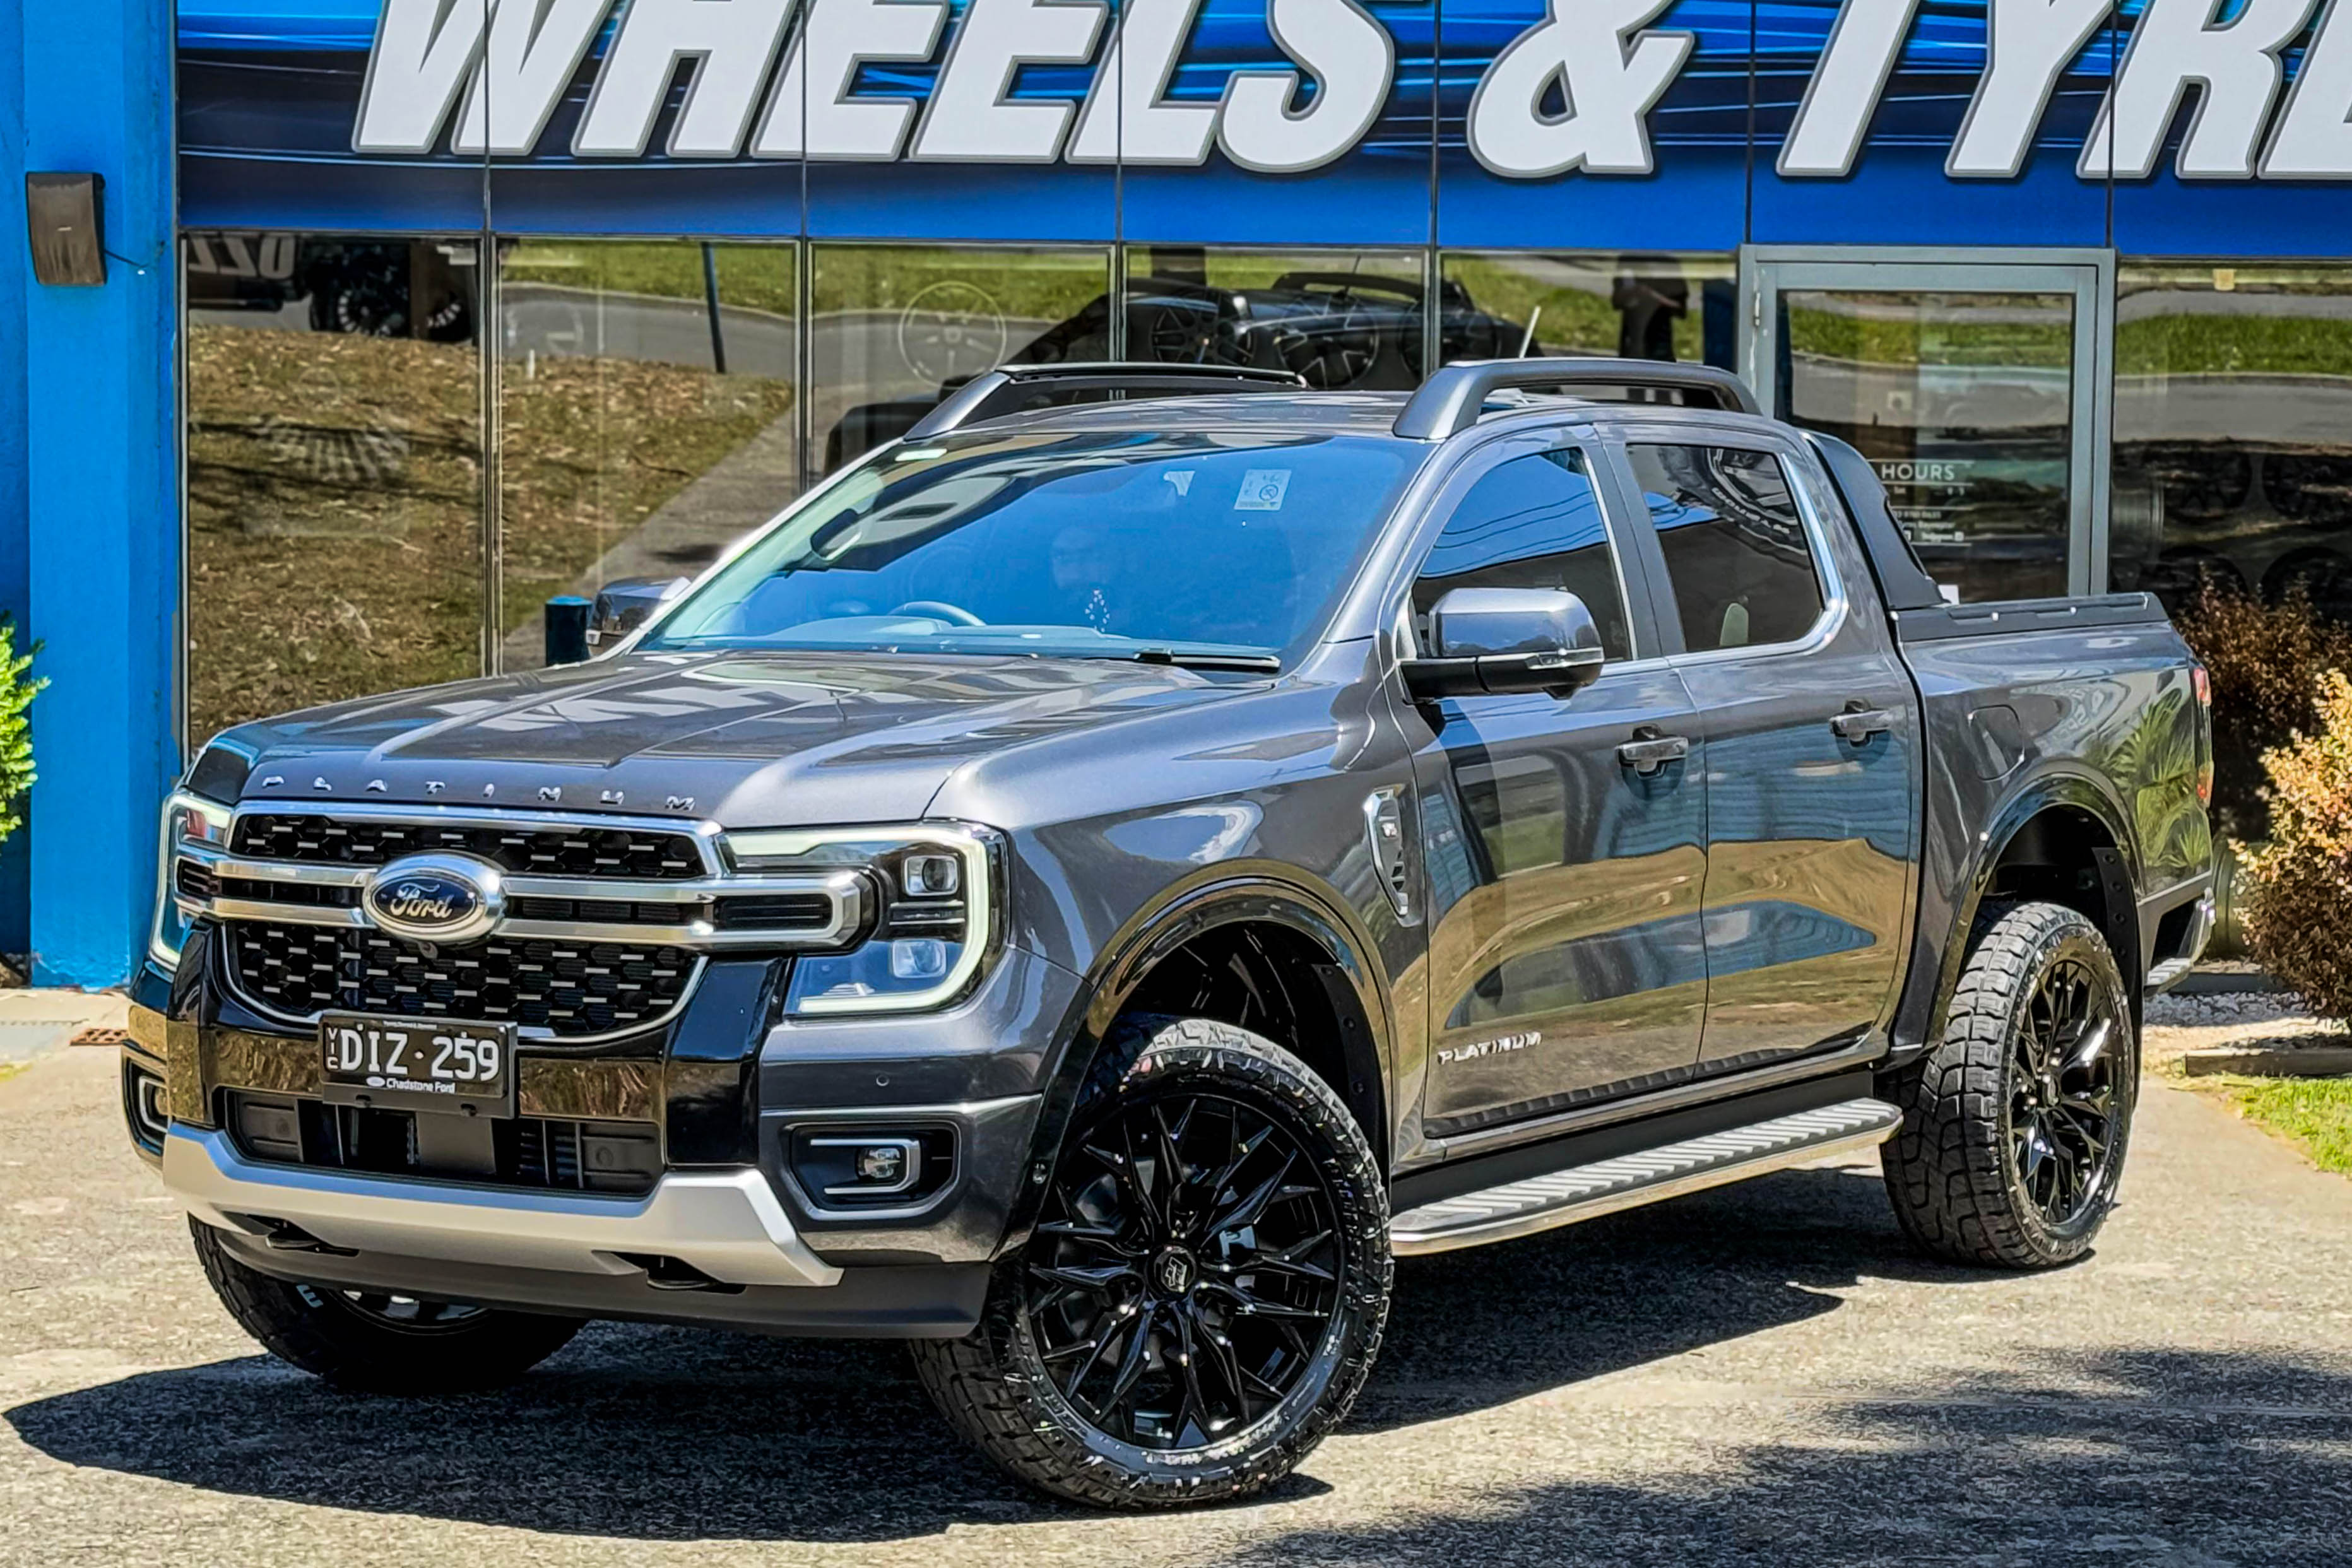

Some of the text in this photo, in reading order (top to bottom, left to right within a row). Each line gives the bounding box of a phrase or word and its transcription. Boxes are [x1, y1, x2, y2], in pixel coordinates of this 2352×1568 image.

[352, 0, 1395, 174] WHEELS
[1466, 0, 1696, 179] &
[1881, 463, 1955, 481] HOURS
[262, 775, 695, 811] PLATINUM
[390, 883, 454, 918] Ford
[327, 1027, 338, 1070] VIC
[341, 1029, 499, 1082] DIZ 259
[1438, 1031, 1542, 1065] PLATINUM
[435, 1081, 456, 1094] Ford
